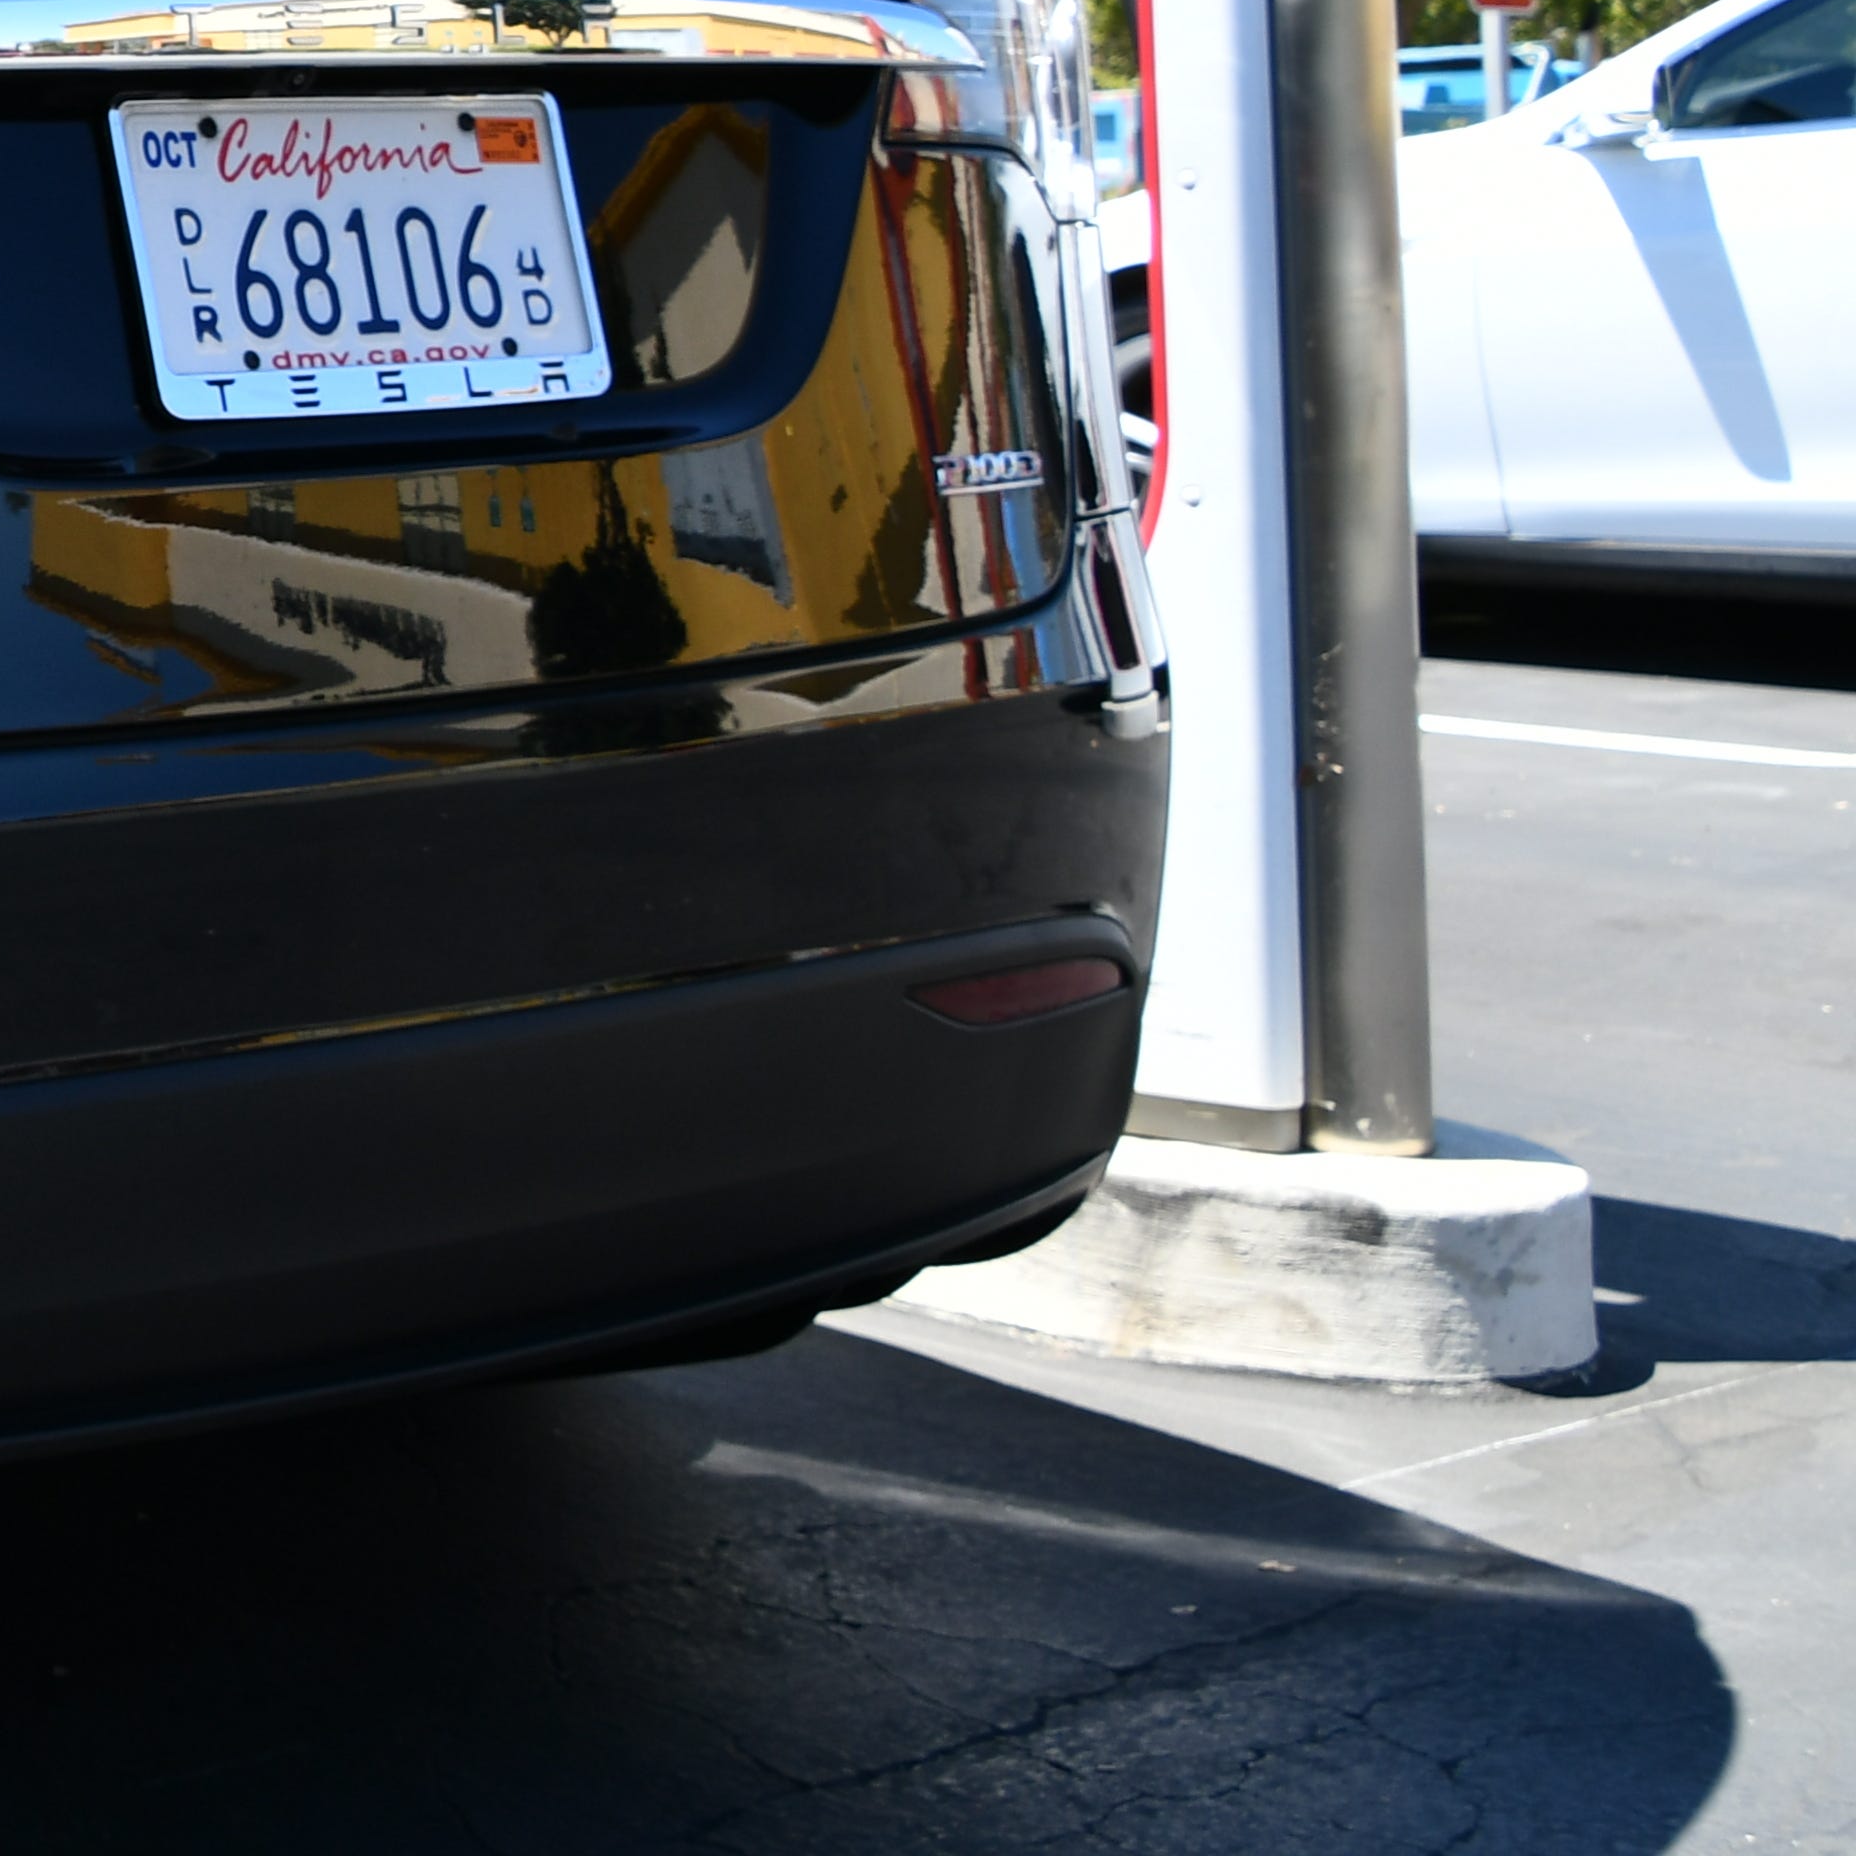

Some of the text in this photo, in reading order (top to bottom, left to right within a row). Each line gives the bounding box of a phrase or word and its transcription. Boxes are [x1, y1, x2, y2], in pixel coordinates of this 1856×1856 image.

[170, 3, 614, 45] TESLA
[142, 131, 197, 168] OCT
[218, 118, 483, 200] California
[236, 204, 503, 339] 68106
[272, 343, 491, 371] dmv.ca.gov
[206, 360, 570, 412] TESLA
